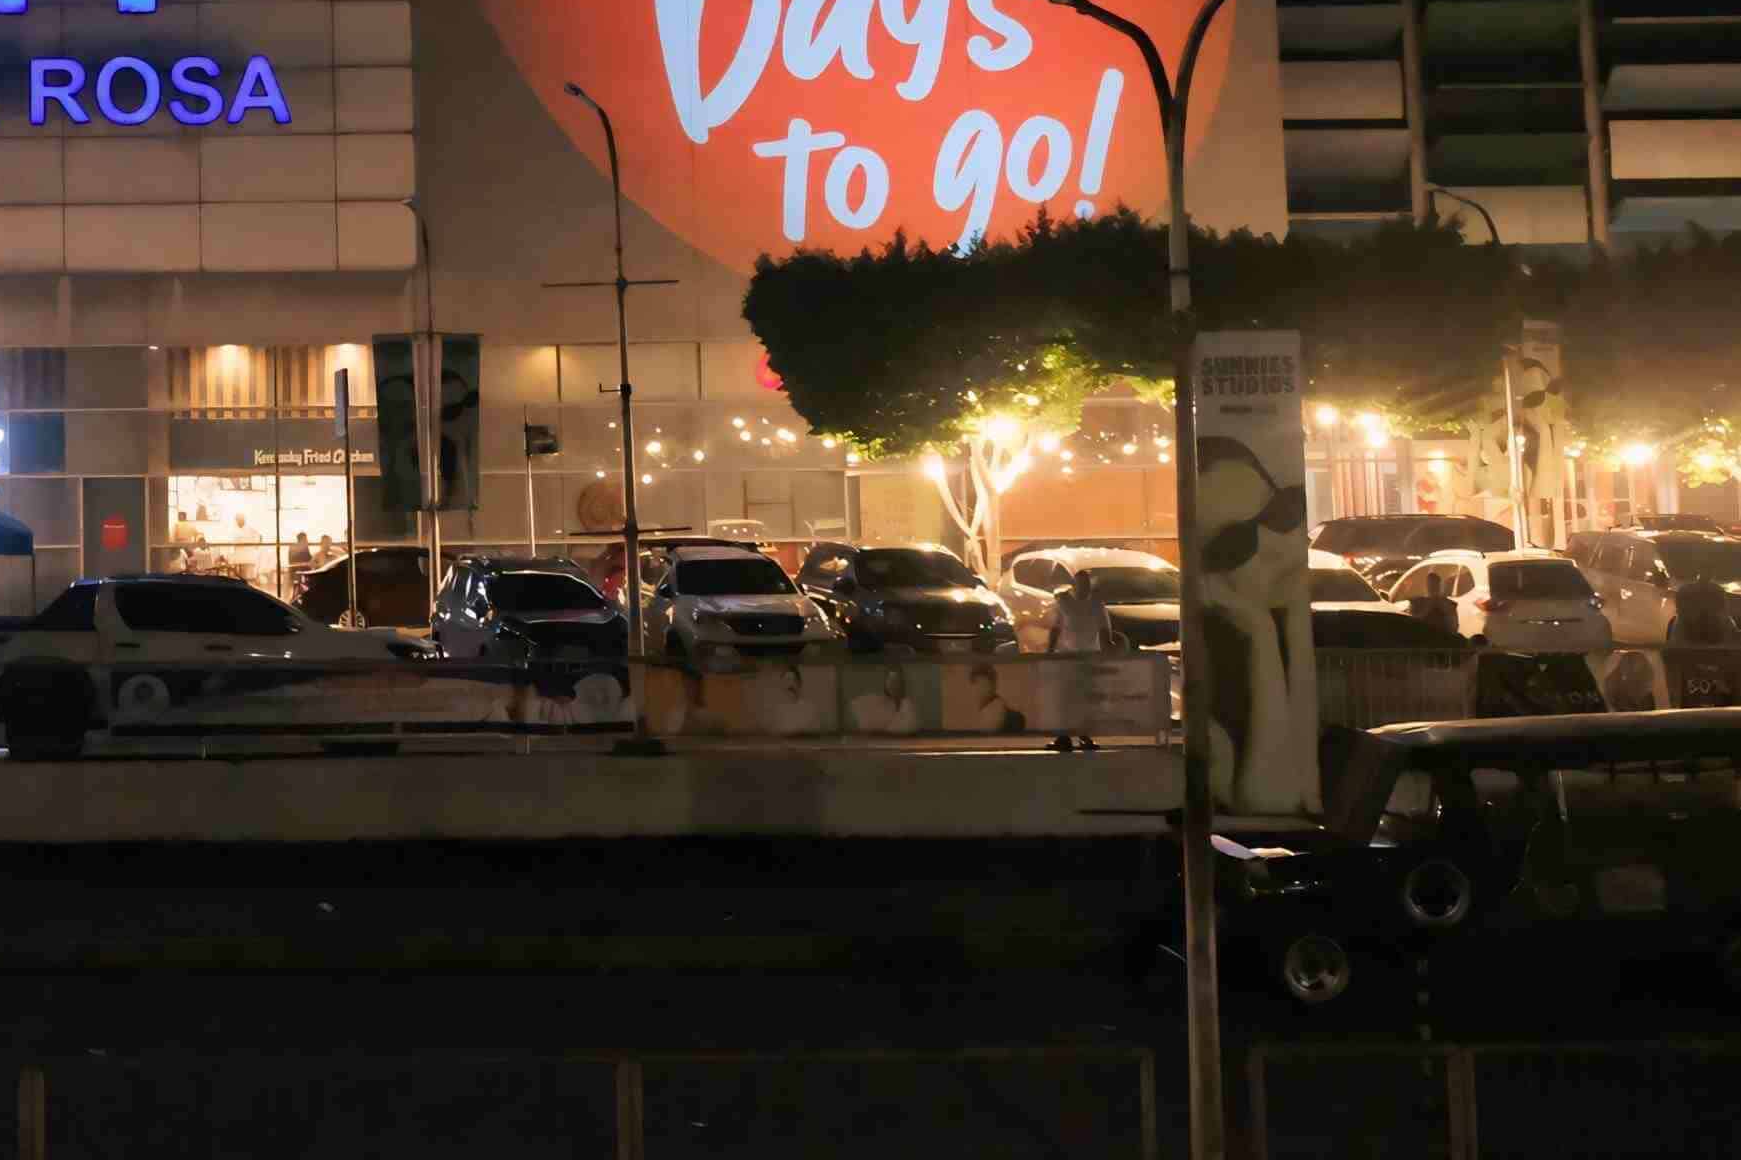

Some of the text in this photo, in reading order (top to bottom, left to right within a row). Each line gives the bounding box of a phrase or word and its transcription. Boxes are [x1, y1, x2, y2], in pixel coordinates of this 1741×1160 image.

[28, 54, 292, 127] ROSA
[753, 68, 1124, 260] to go!
[1201, 376, 1296, 395] STUDIOS
[303, 448, 331, 465] Fried
